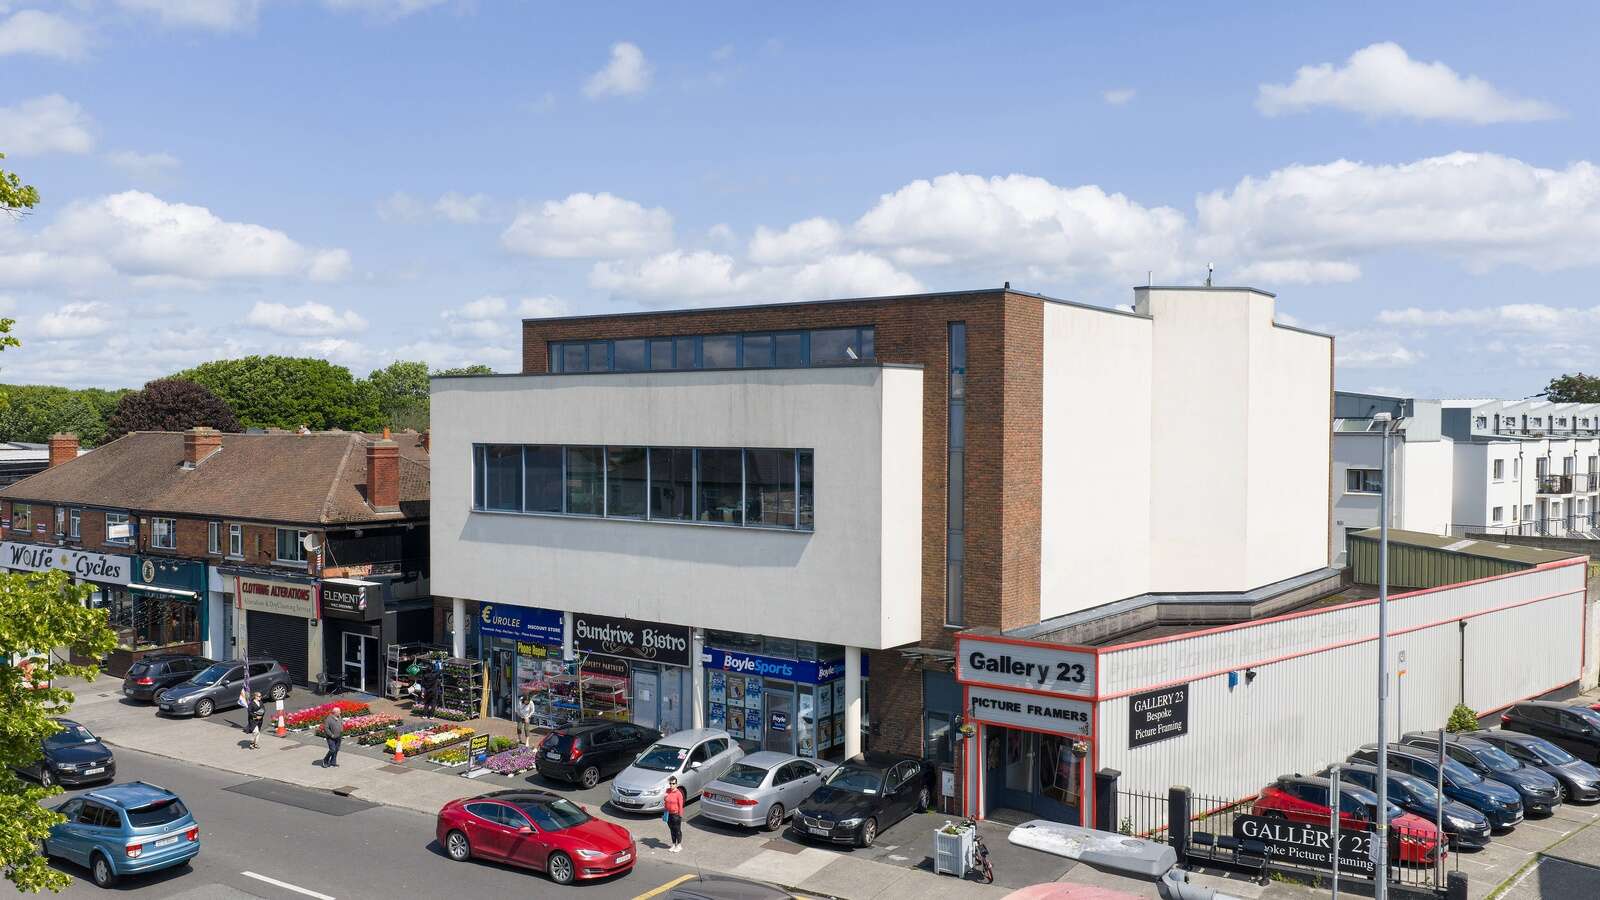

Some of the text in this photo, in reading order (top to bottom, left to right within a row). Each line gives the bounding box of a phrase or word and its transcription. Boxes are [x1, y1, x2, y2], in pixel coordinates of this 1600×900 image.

[11, 545, 121, 578] Wolfe Cycles
[242, 582, 310, 601] CLOTHING ALTERATIONS
[324, 591, 361, 605] ELEMENT
[527, 624, 547, 632] DISCOUNT
[576, 619, 686, 652] Sundrive Bistro
[723, 655, 793, 677] BoyleSports
[969, 652, 1086, 684] Gallery 23
[971, 696, 1088, 723] PICTURE FRAMERS
[1134, 691, 1184, 712] GALLERY 23
[1146, 708, 1172, 722] Bespoke
[1135, 719, 1182, 740] Picture Framing
[1242, 820, 1346, 850] GALLERY
[1289, 846, 1325, 862] Picture
